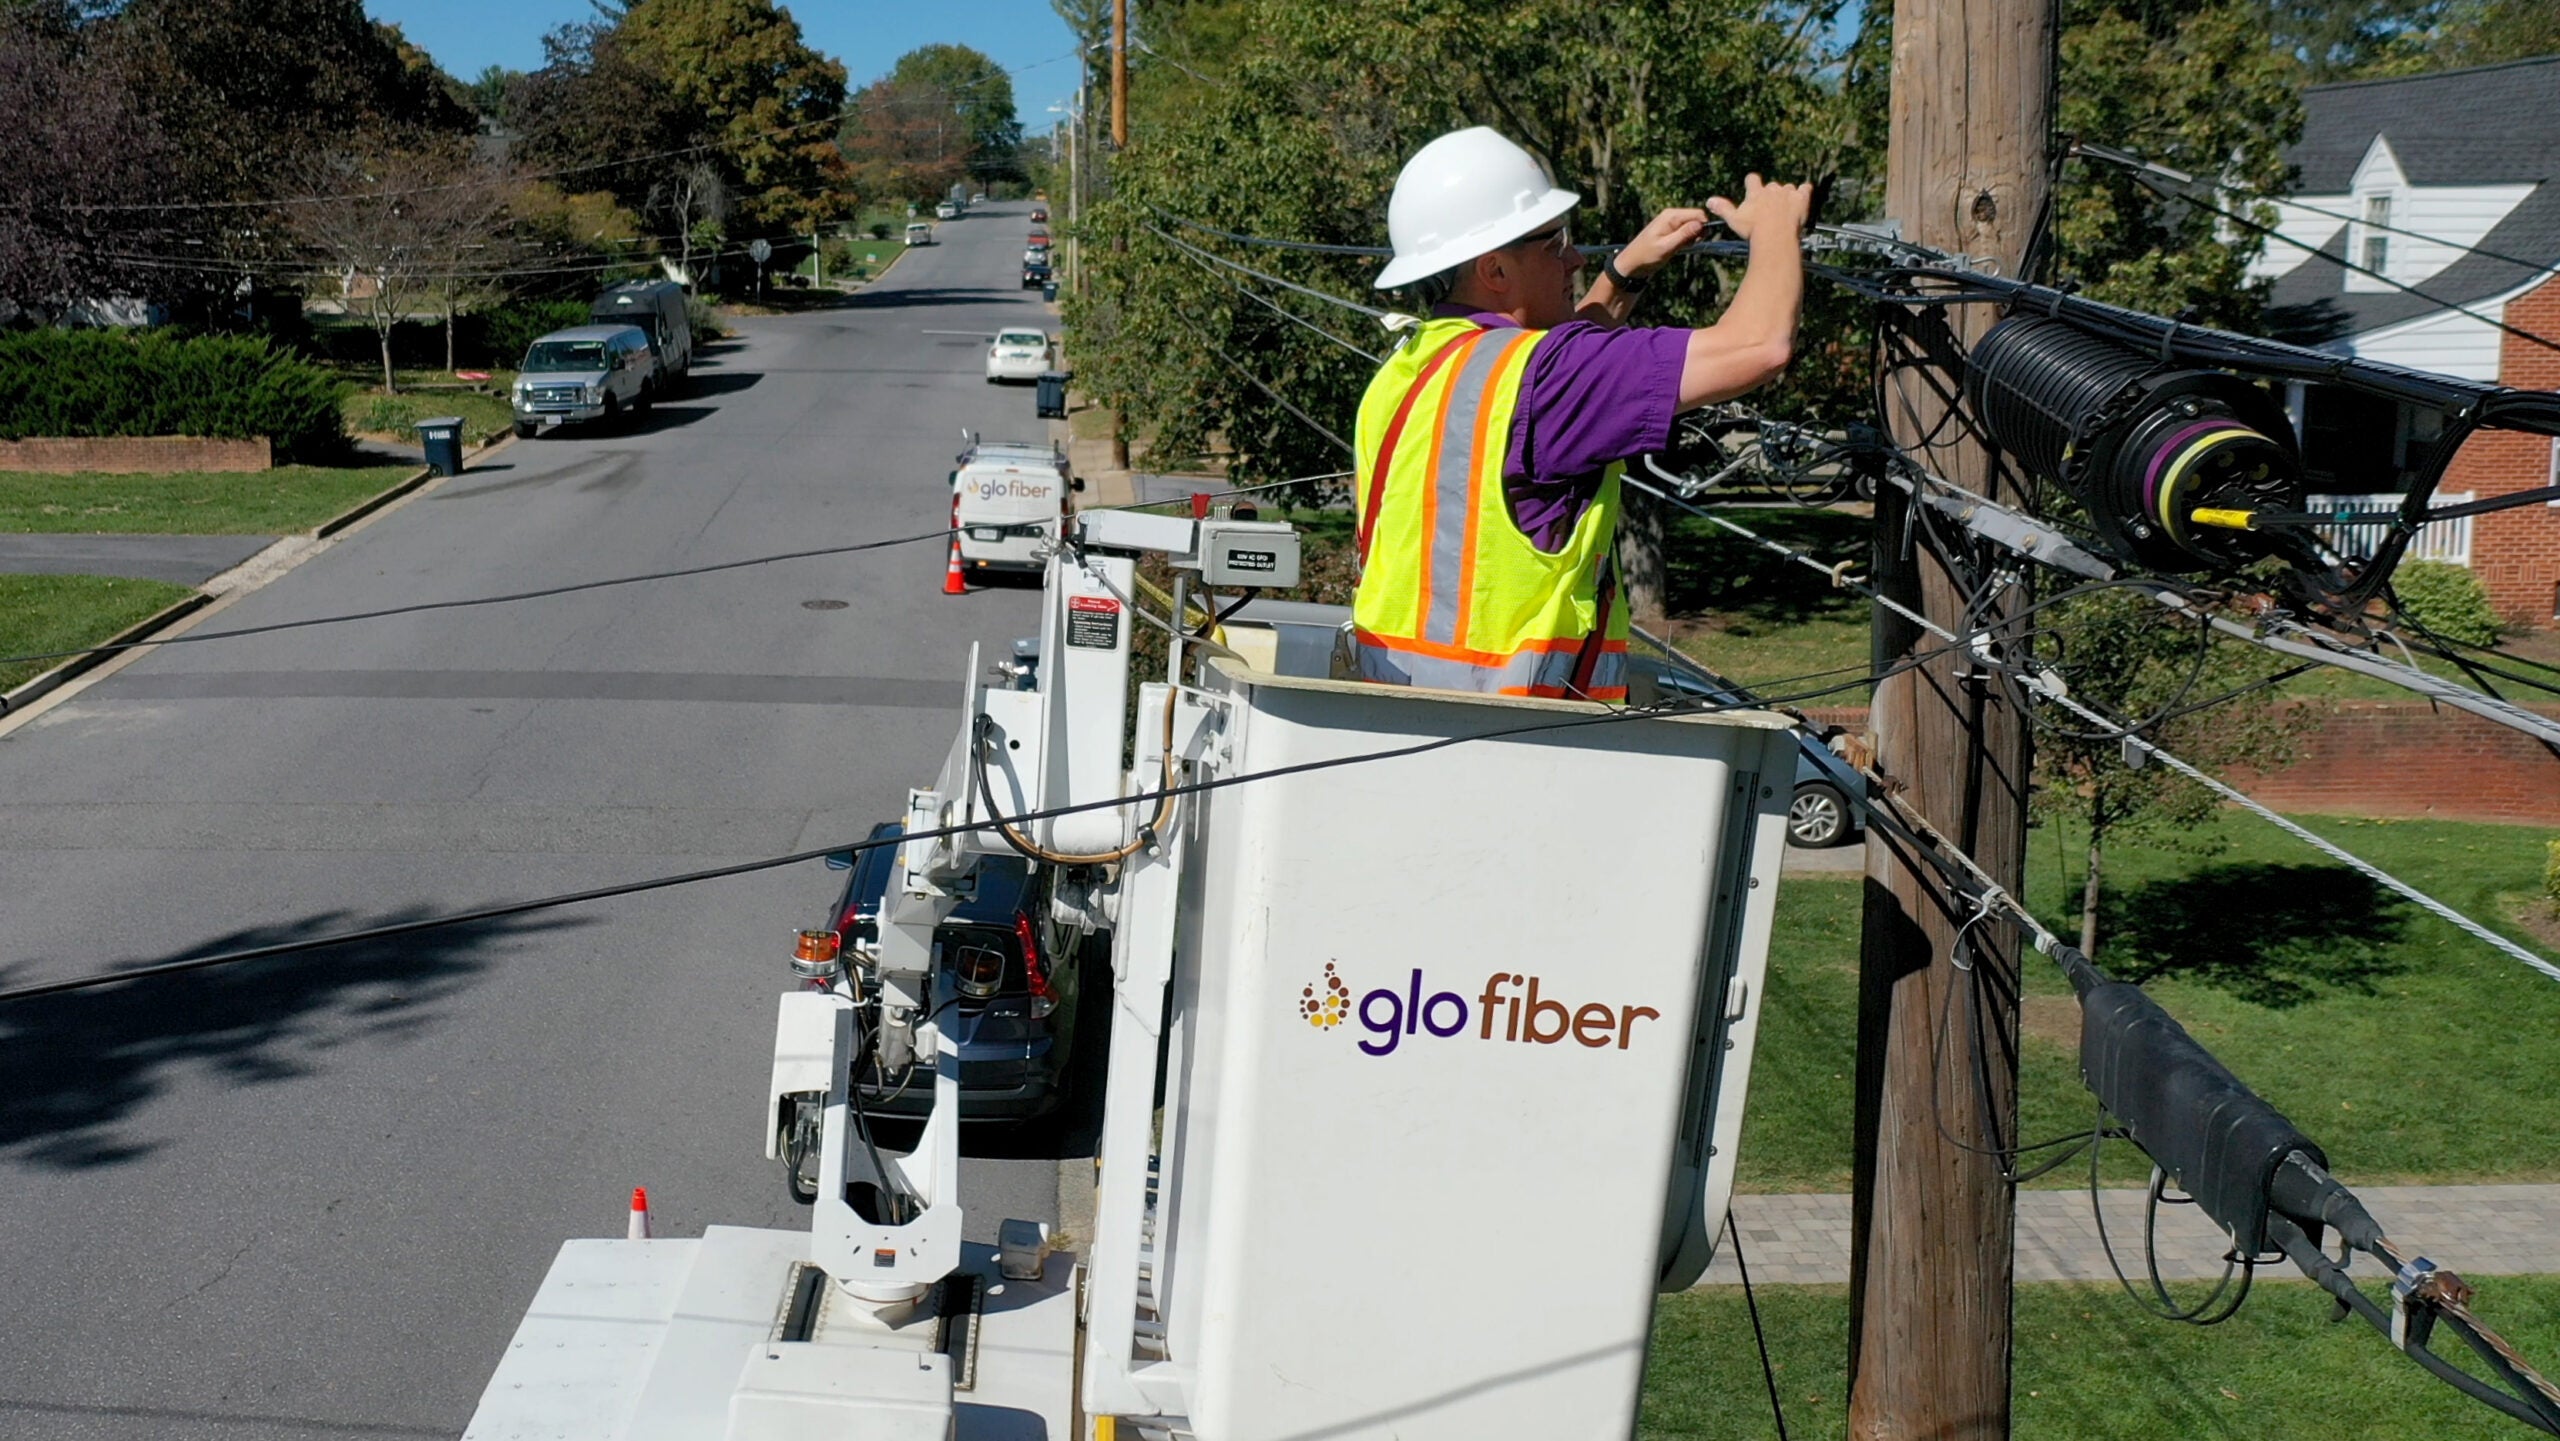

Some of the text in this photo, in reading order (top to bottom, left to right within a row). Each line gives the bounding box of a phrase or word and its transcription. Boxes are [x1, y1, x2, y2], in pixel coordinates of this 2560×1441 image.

[980, 480, 1052, 501] glo fiber
[1357, 968, 1661, 1056] glo fiber
